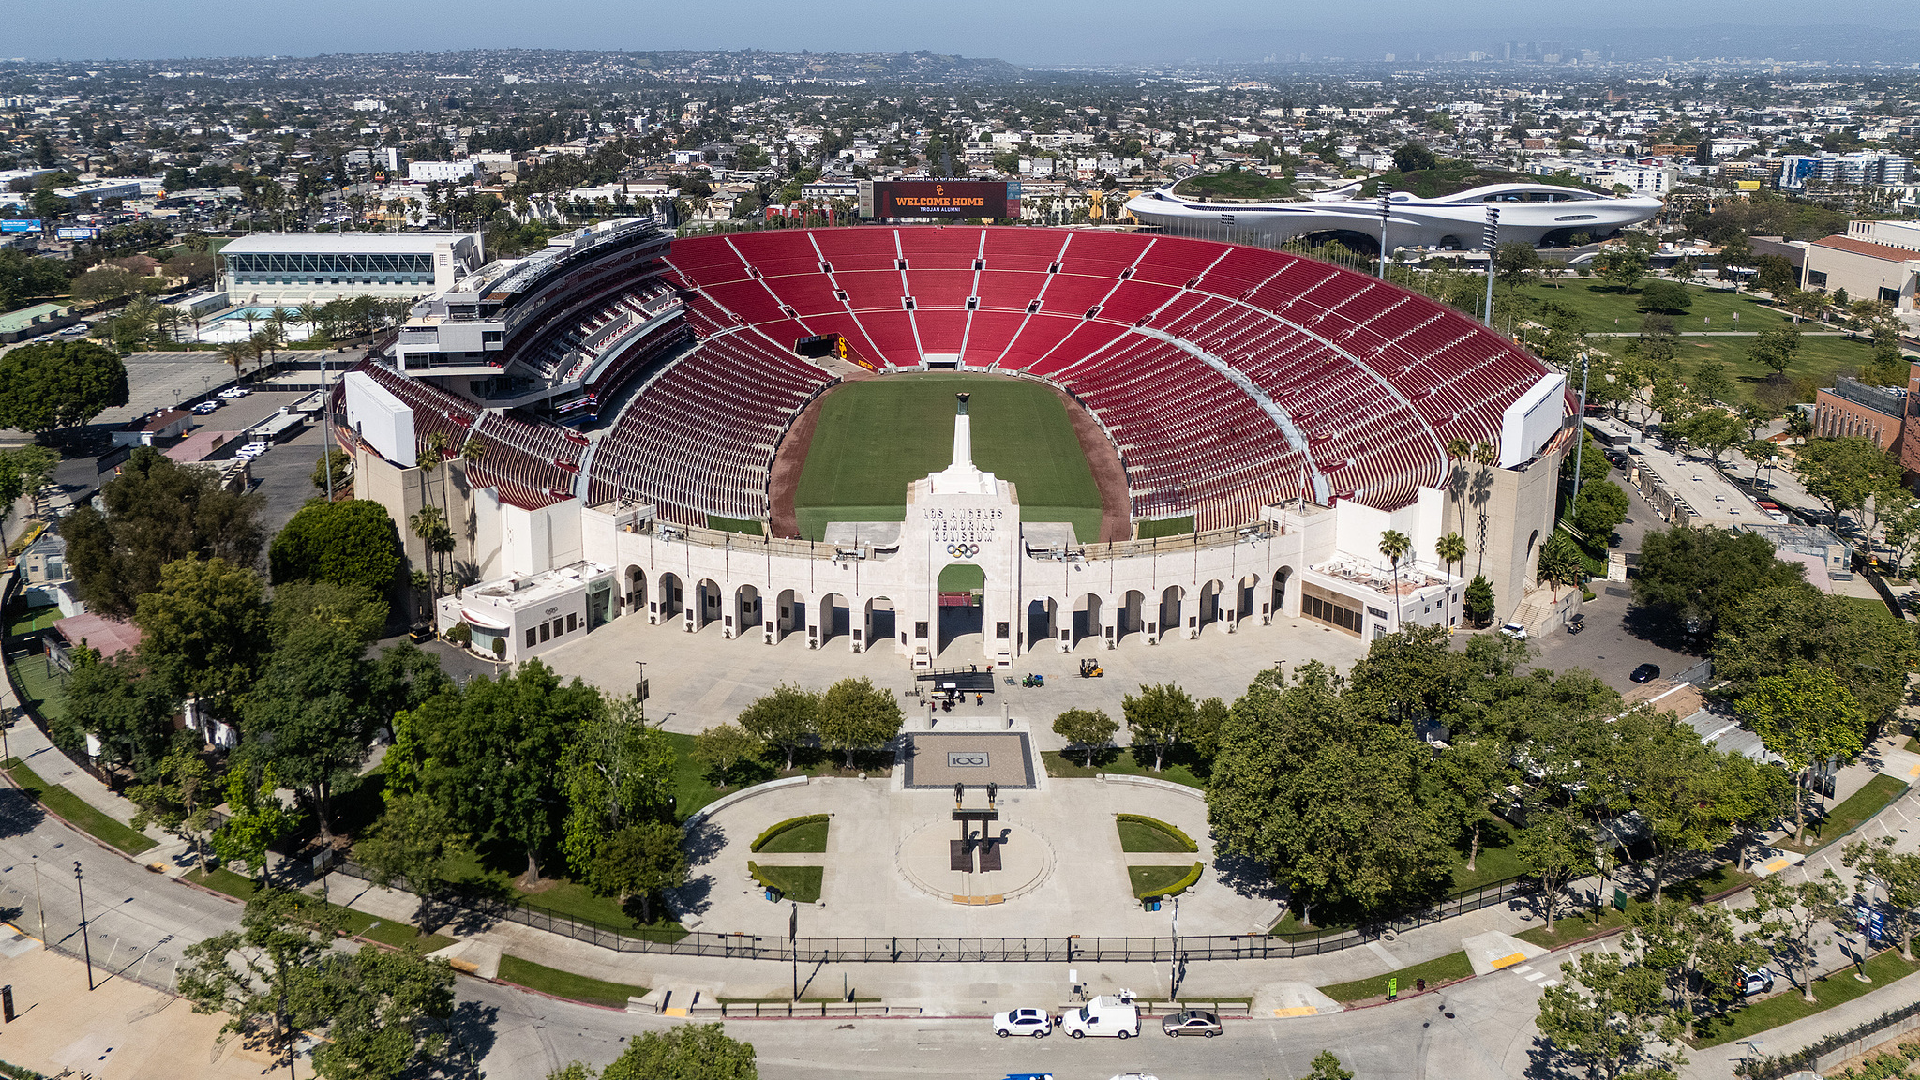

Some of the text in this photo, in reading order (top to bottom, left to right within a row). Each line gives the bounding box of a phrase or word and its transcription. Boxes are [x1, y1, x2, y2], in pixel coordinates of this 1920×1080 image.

[895, 197, 984, 206] WELCOME HOME
[923, 508, 1003, 520] LOS ANGELES
[932, 520, 996, 531] MEMORIAL
[934, 531, 993, 542] COLISEUM
